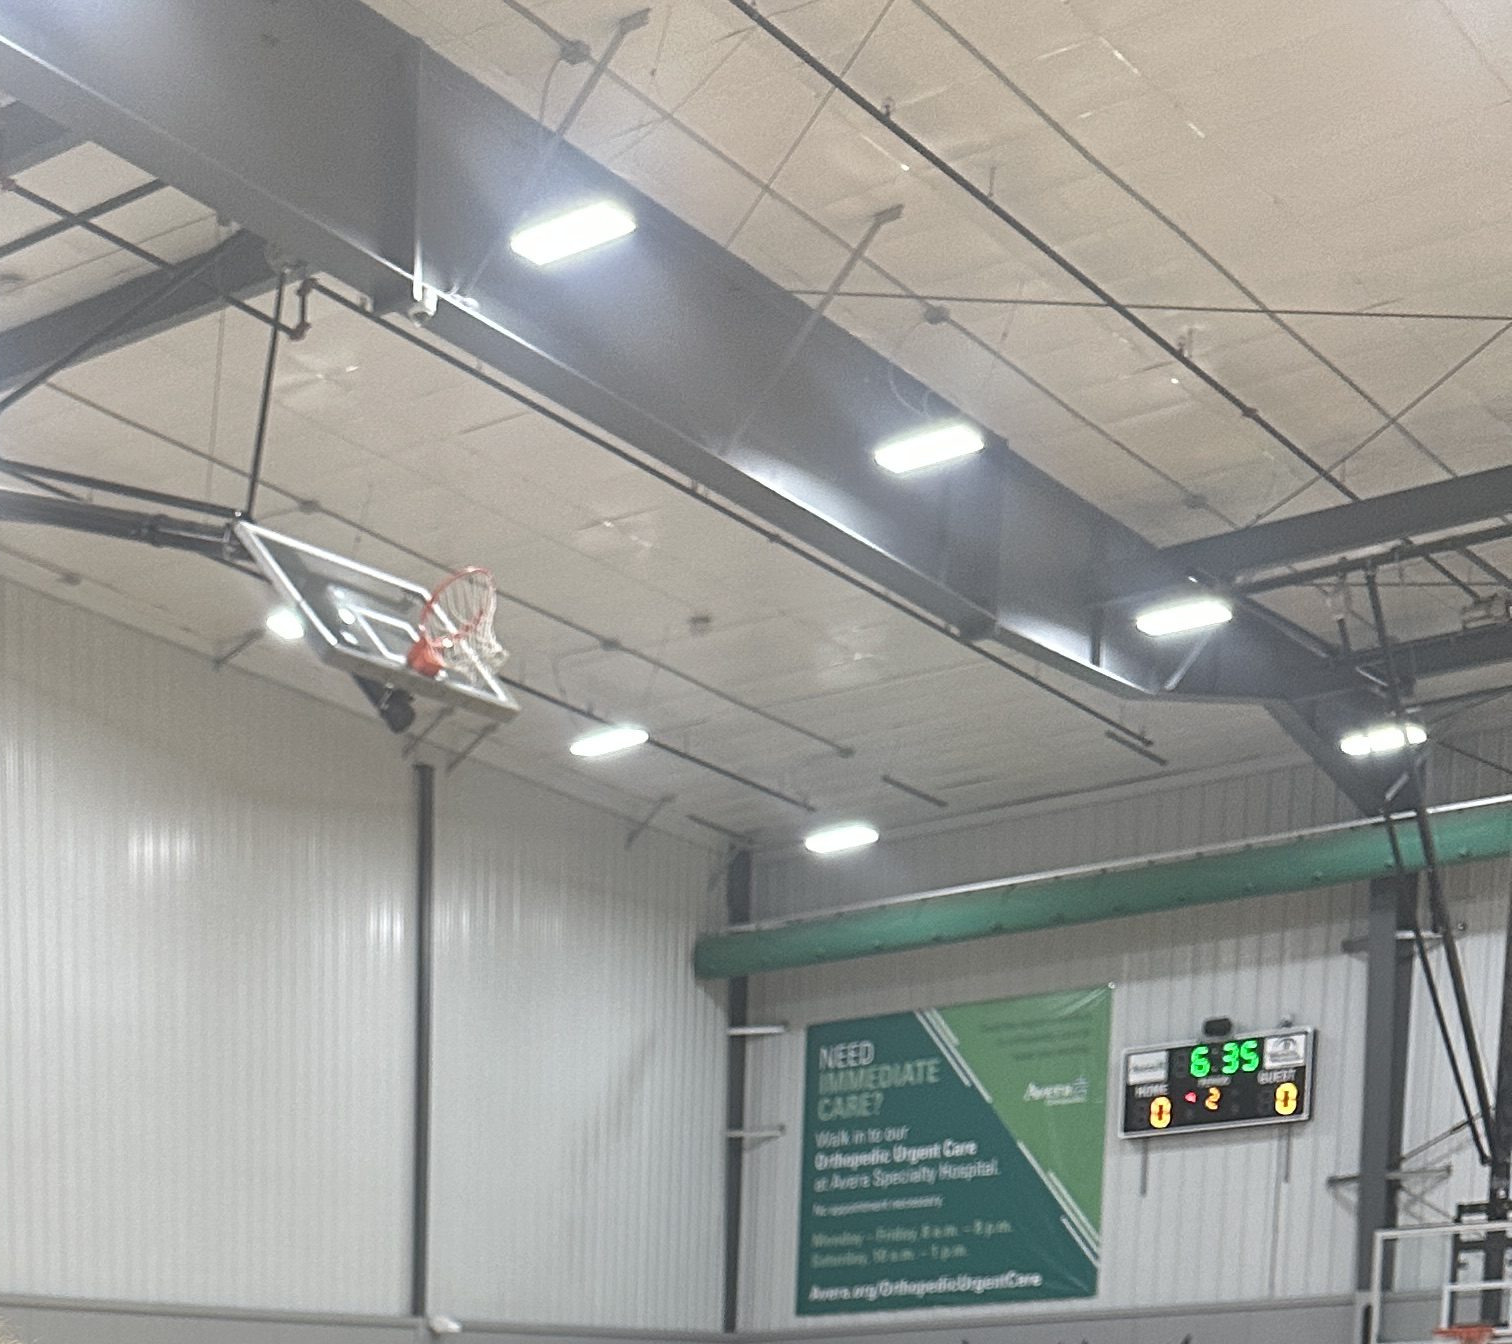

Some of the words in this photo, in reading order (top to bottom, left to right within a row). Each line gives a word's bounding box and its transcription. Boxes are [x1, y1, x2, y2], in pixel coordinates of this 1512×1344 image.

[819, 1040, 874, 1070] NEED
[818, 1058, 941, 1095] IMMEDIATE
[817, 1090, 884, 1121] CARE?
[1149, 1096, 1172, 1129] 0
[1205, 1086, 1221, 1111] 2
[1274, 1082, 1298, 1116] 0
[815, 1129, 850, 1149] Walk
[814, 1148, 891, 1172] Orthopedic
[893, 1142, 941, 1166] Urgent
[943, 1138, 978, 1158] Care
[830, 1173, 871, 1190] Avera
[873, 1166, 936, 1189] Specialty
